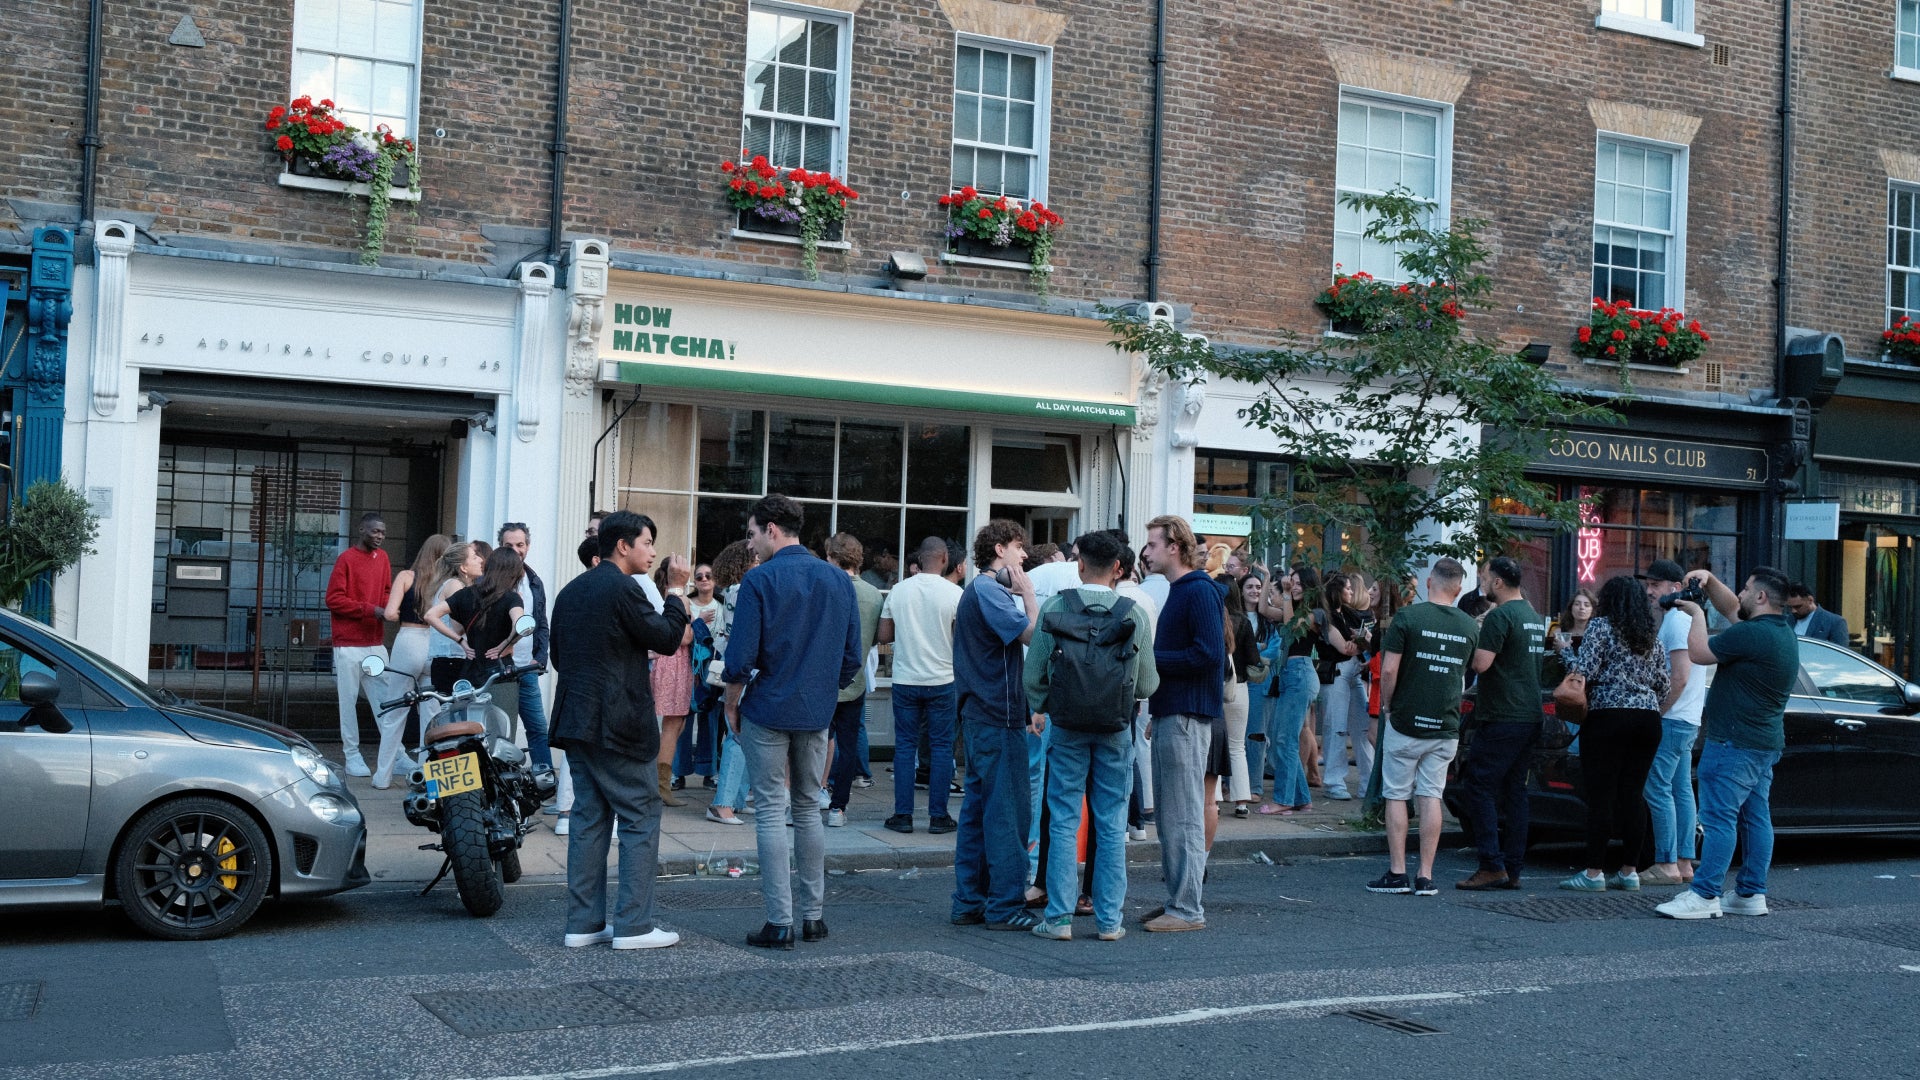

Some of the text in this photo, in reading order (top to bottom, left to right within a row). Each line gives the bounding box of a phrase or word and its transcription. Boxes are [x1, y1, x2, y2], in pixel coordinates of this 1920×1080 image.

[614, 303, 672, 328] HOW
[140, 332, 501, 372] 45 ADMIRAL COURT 45
[613, 329, 738, 360] MATCHA!
[1036, 402, 1126, 417] ALL DAY MATCHA BAR
[1549, 438, 1706, 468] COCO NAILS CLUB
[1746, 468, 1757, 480] 51
[1578, 539, 1601, 559] UB
[1421, 630, 1467, 644] HOW MATCHA
[1416, 652, 1463, 665] MARYLEBONE
[1428, 665, 1449, 674] BOYS
[429, 755, 470, 778] RE17
[437, 771, 474, 792] NFG
